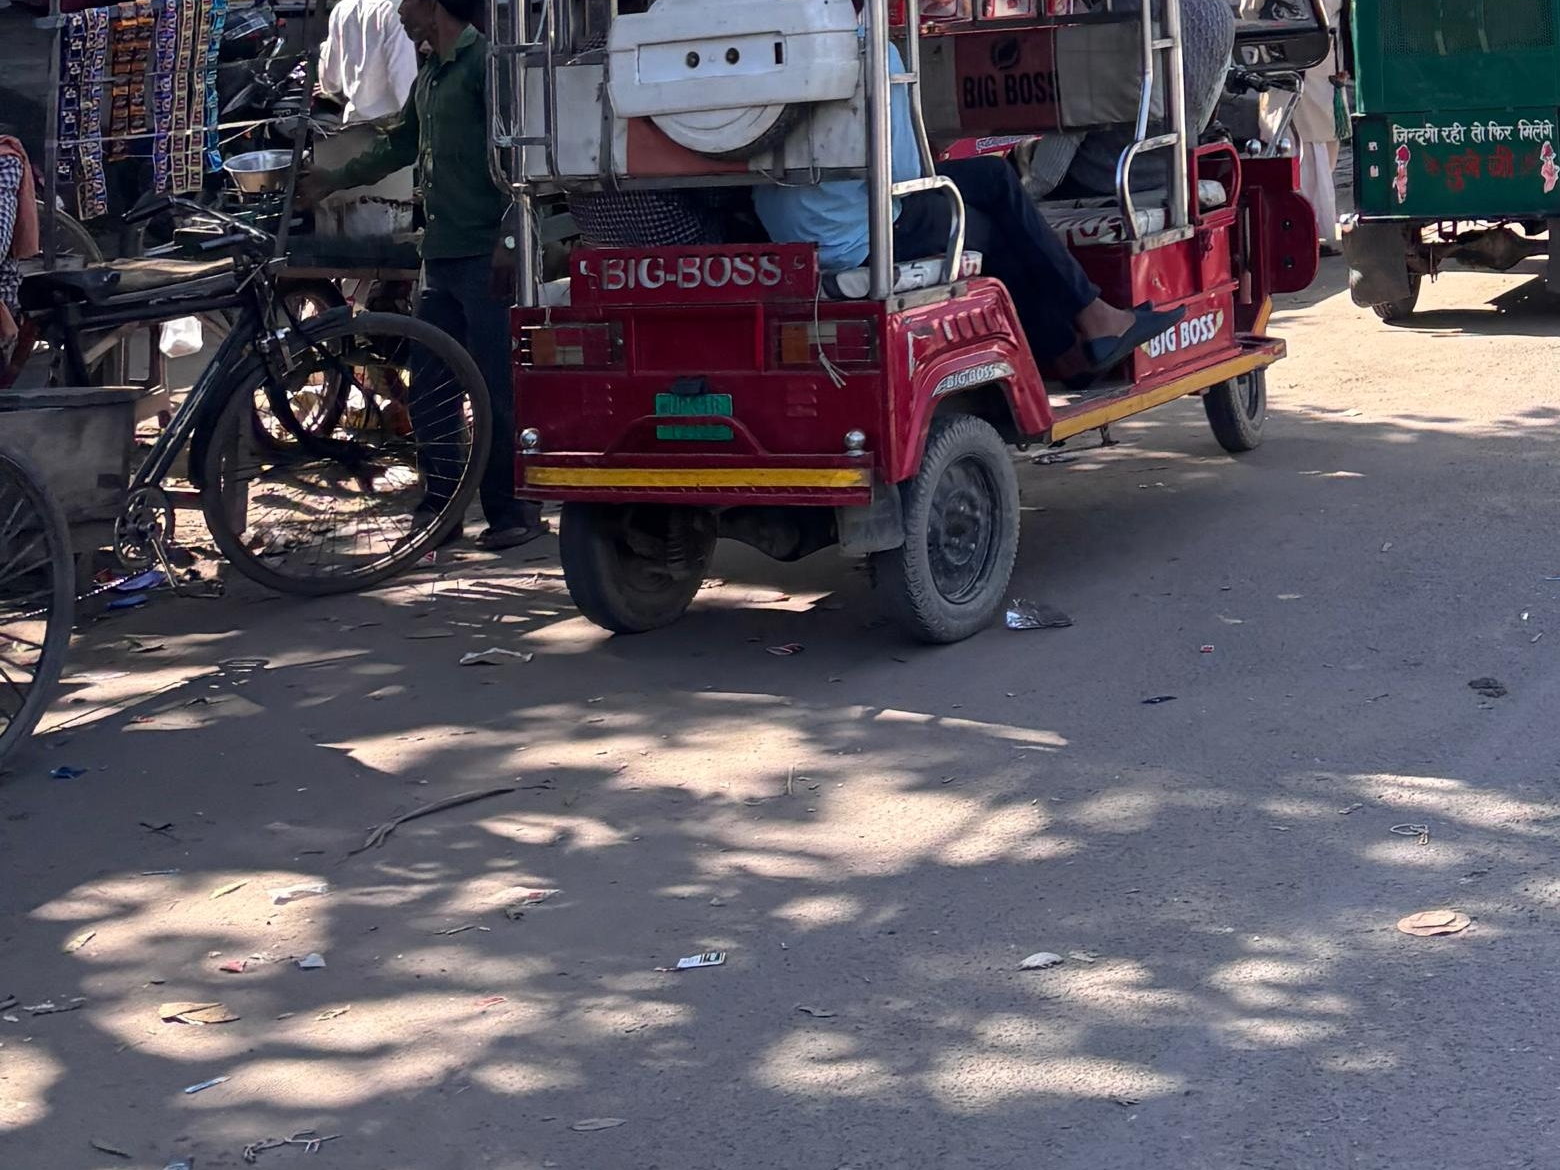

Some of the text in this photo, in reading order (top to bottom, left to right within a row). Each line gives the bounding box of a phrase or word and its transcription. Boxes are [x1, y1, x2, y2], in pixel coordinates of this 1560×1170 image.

[963, 73, 999, 109] BIG
[1441, 121, 1467, 145] रही
[1487, 120, 1514, 142] फिर
[602, 252, 783, 291] BIG-BOSS
[1150, 312, 1215, 359] BIG BOSS
[968, 363, 994, 383] BOSS
